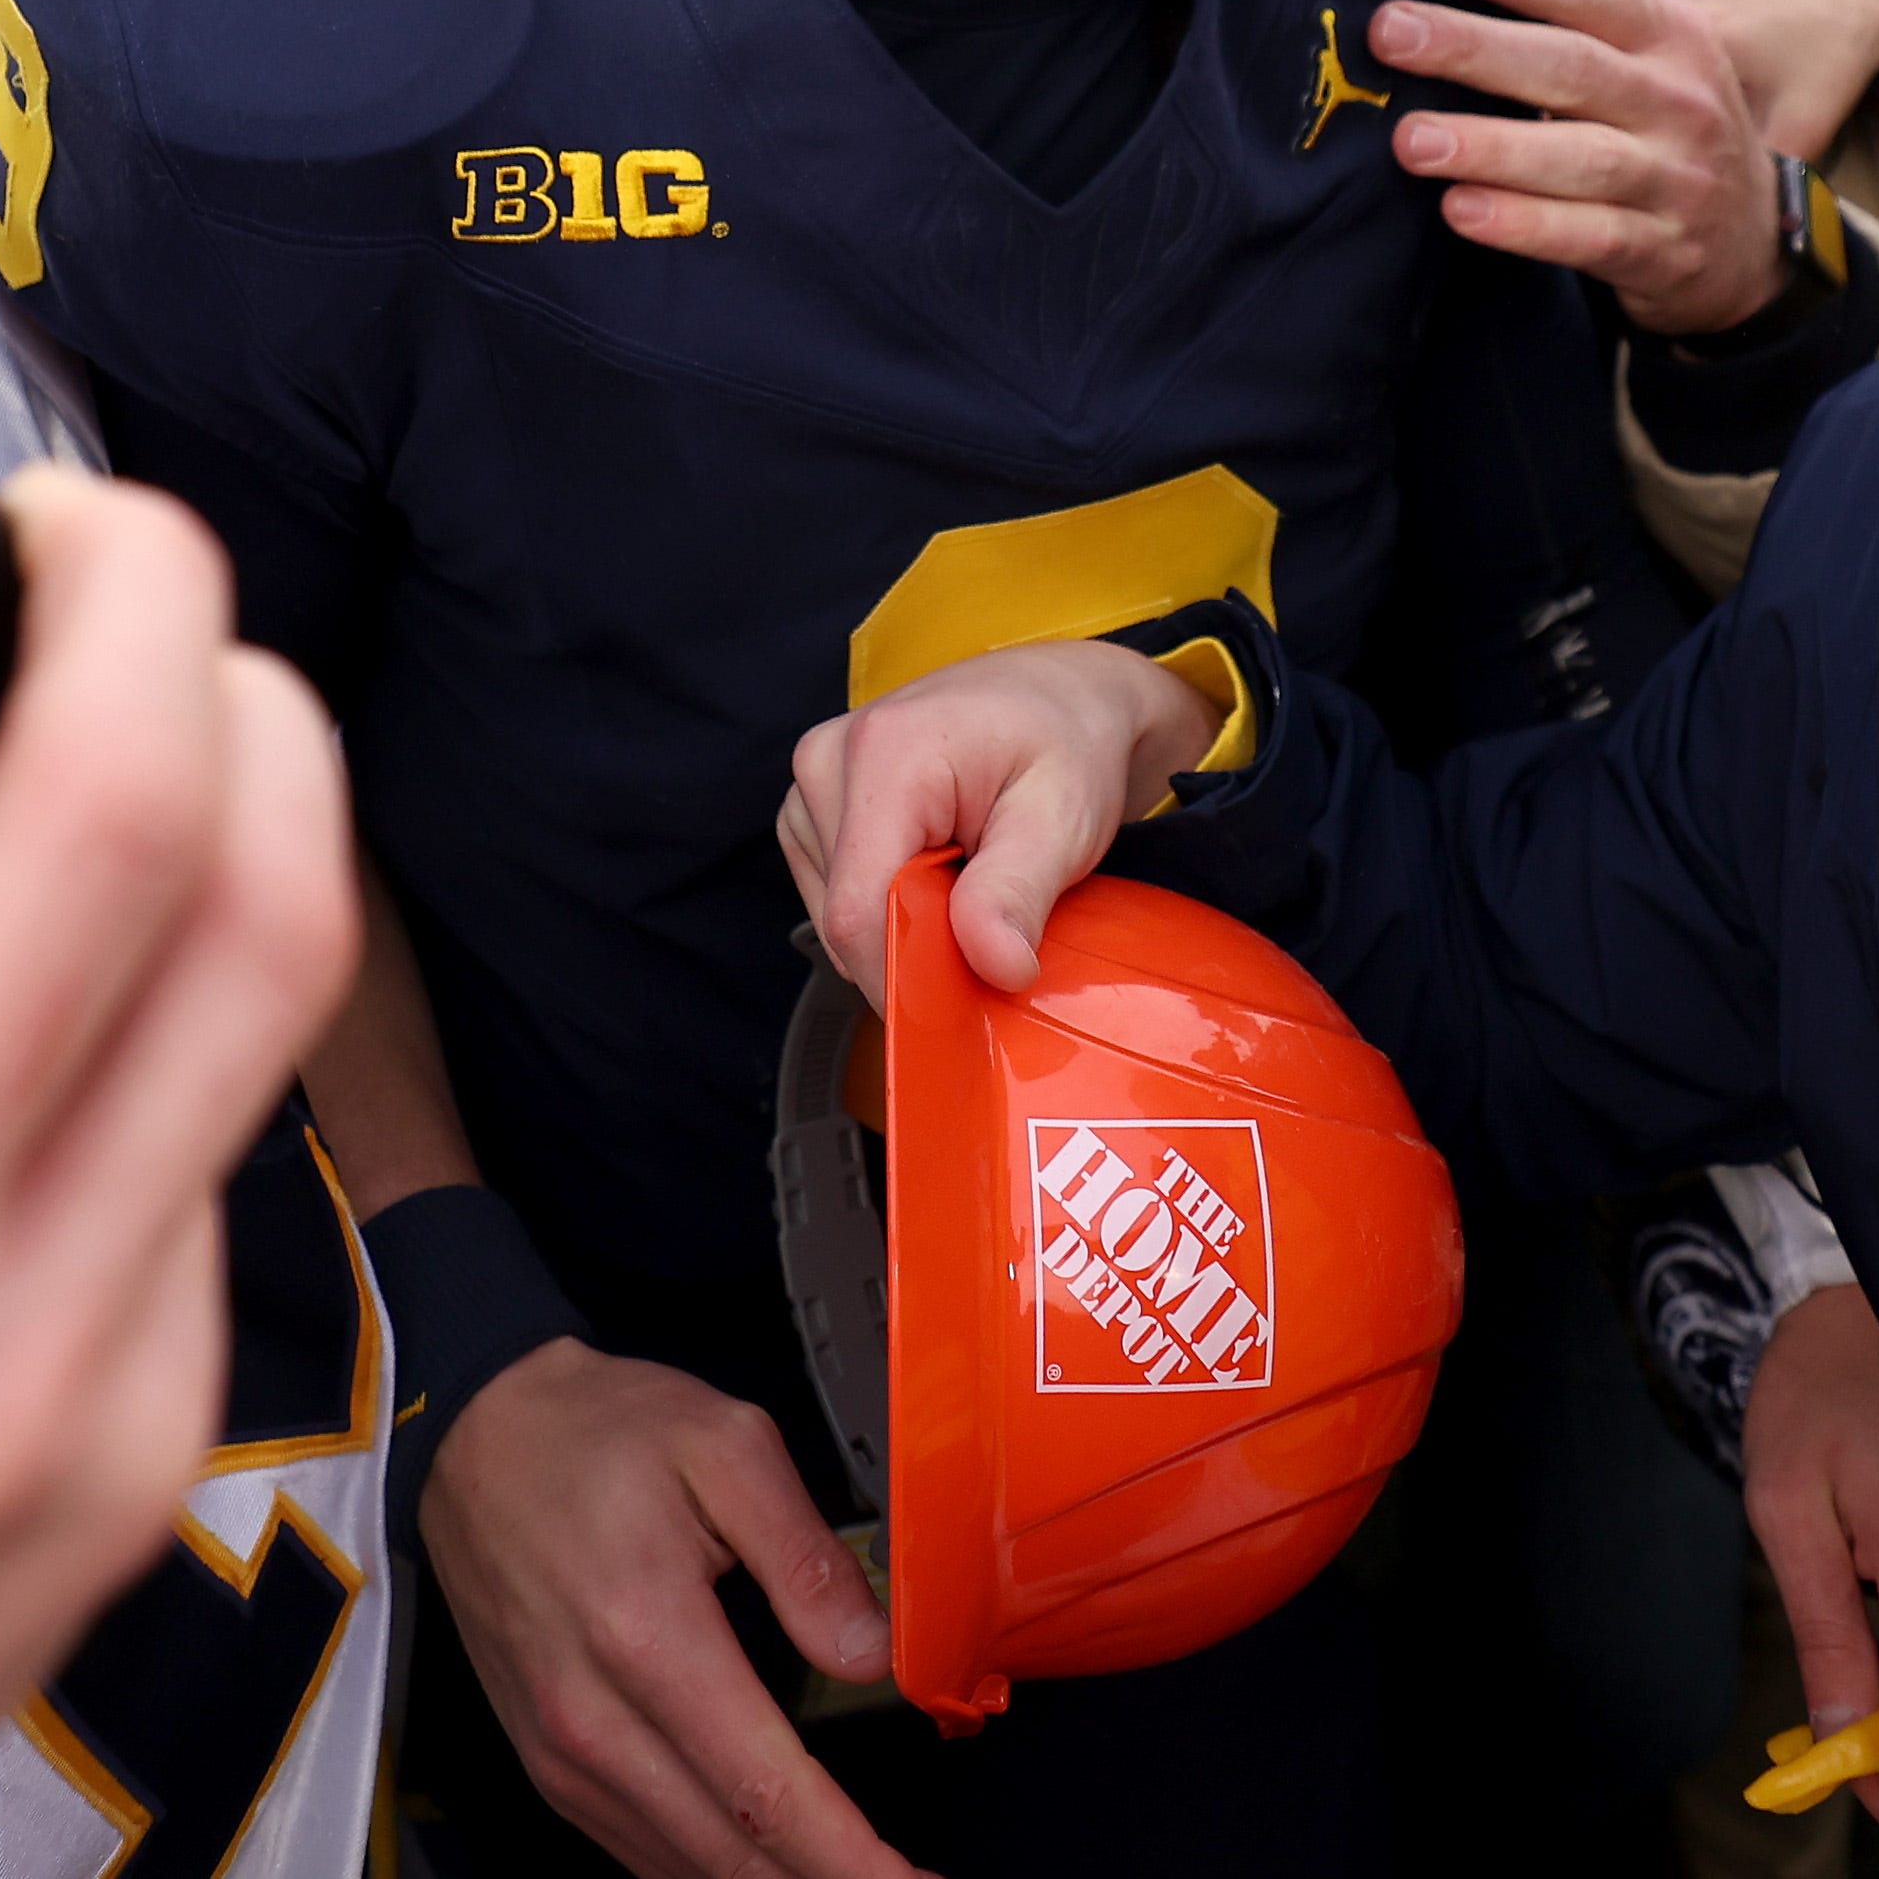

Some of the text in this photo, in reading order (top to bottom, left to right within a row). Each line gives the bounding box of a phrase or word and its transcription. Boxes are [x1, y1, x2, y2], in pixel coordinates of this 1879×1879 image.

[1037, 1125, 1271, 1385] HOME
[1153, 1147, 1246, 1258] THE
[1041, 1223, 1191, 1386] DEPOT
